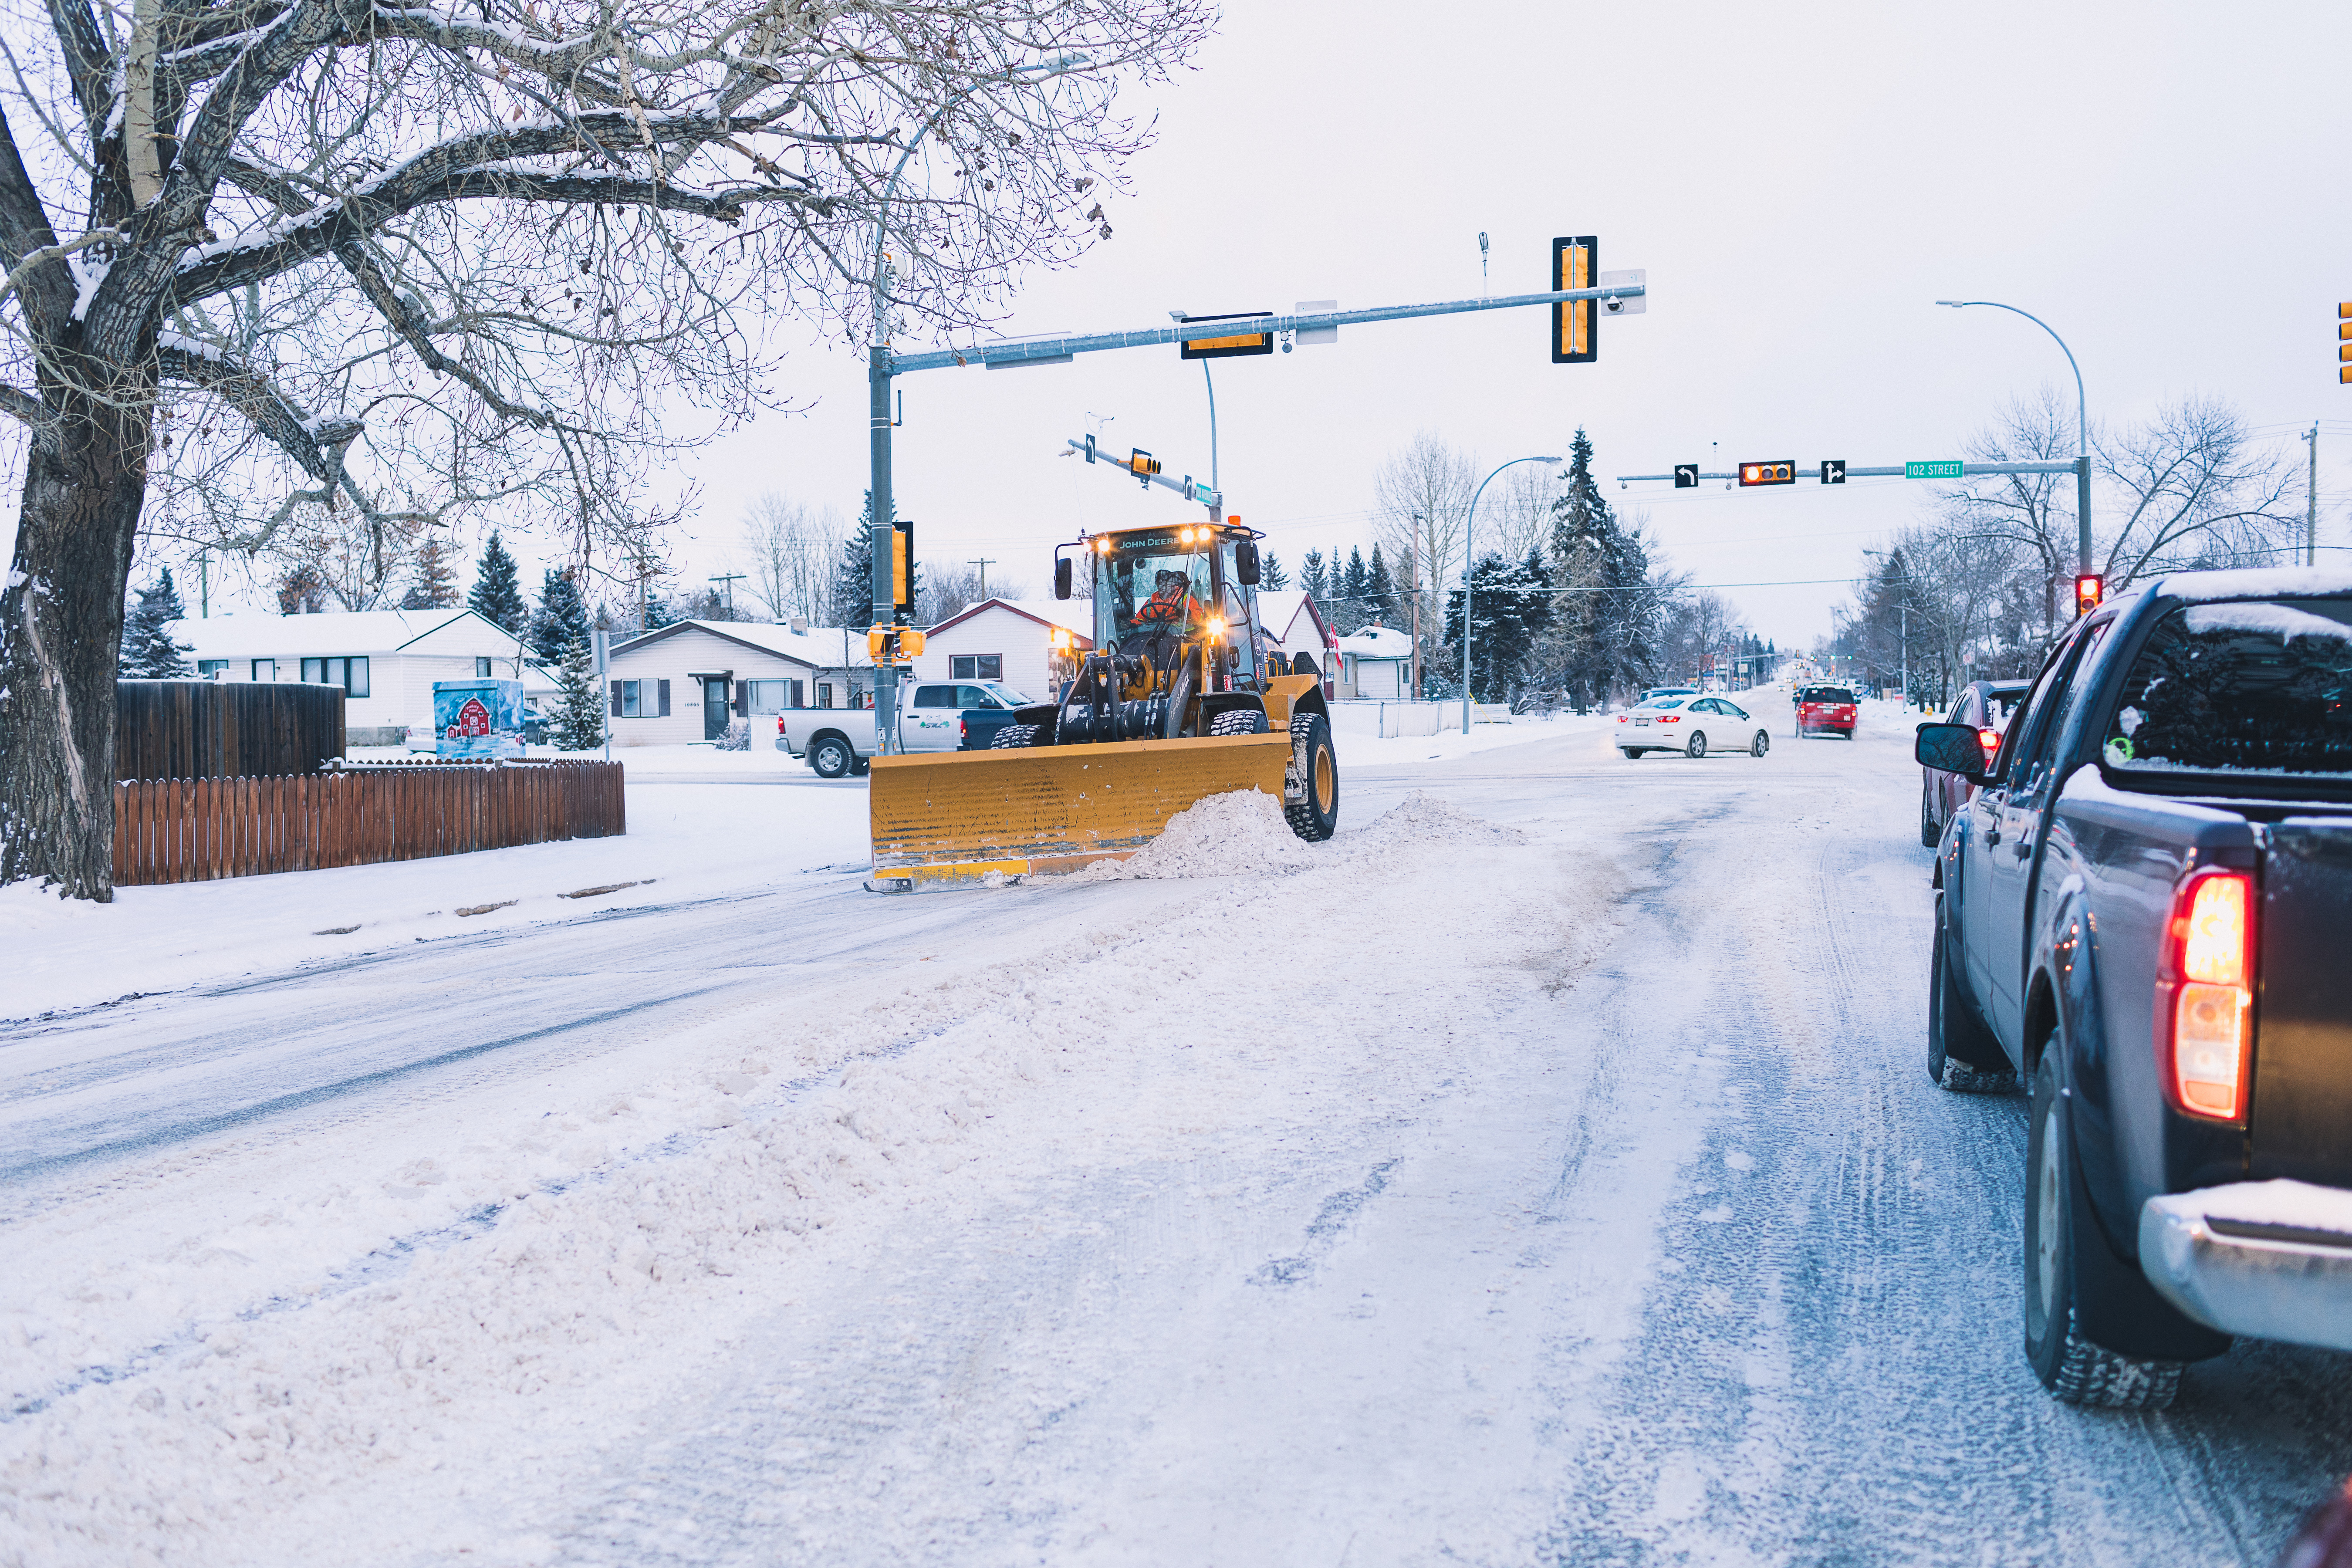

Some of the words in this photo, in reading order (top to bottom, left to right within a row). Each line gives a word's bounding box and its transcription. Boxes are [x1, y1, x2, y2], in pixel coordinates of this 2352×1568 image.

[1909, 465, 1925, 475] 102
[1928, 464, 1960, 475] STREET
[1119, 541, 1145, 549] JOHN
[1147, 537, 1179, 546] DEERE
[1179, 672, 1190, 698] 444K
